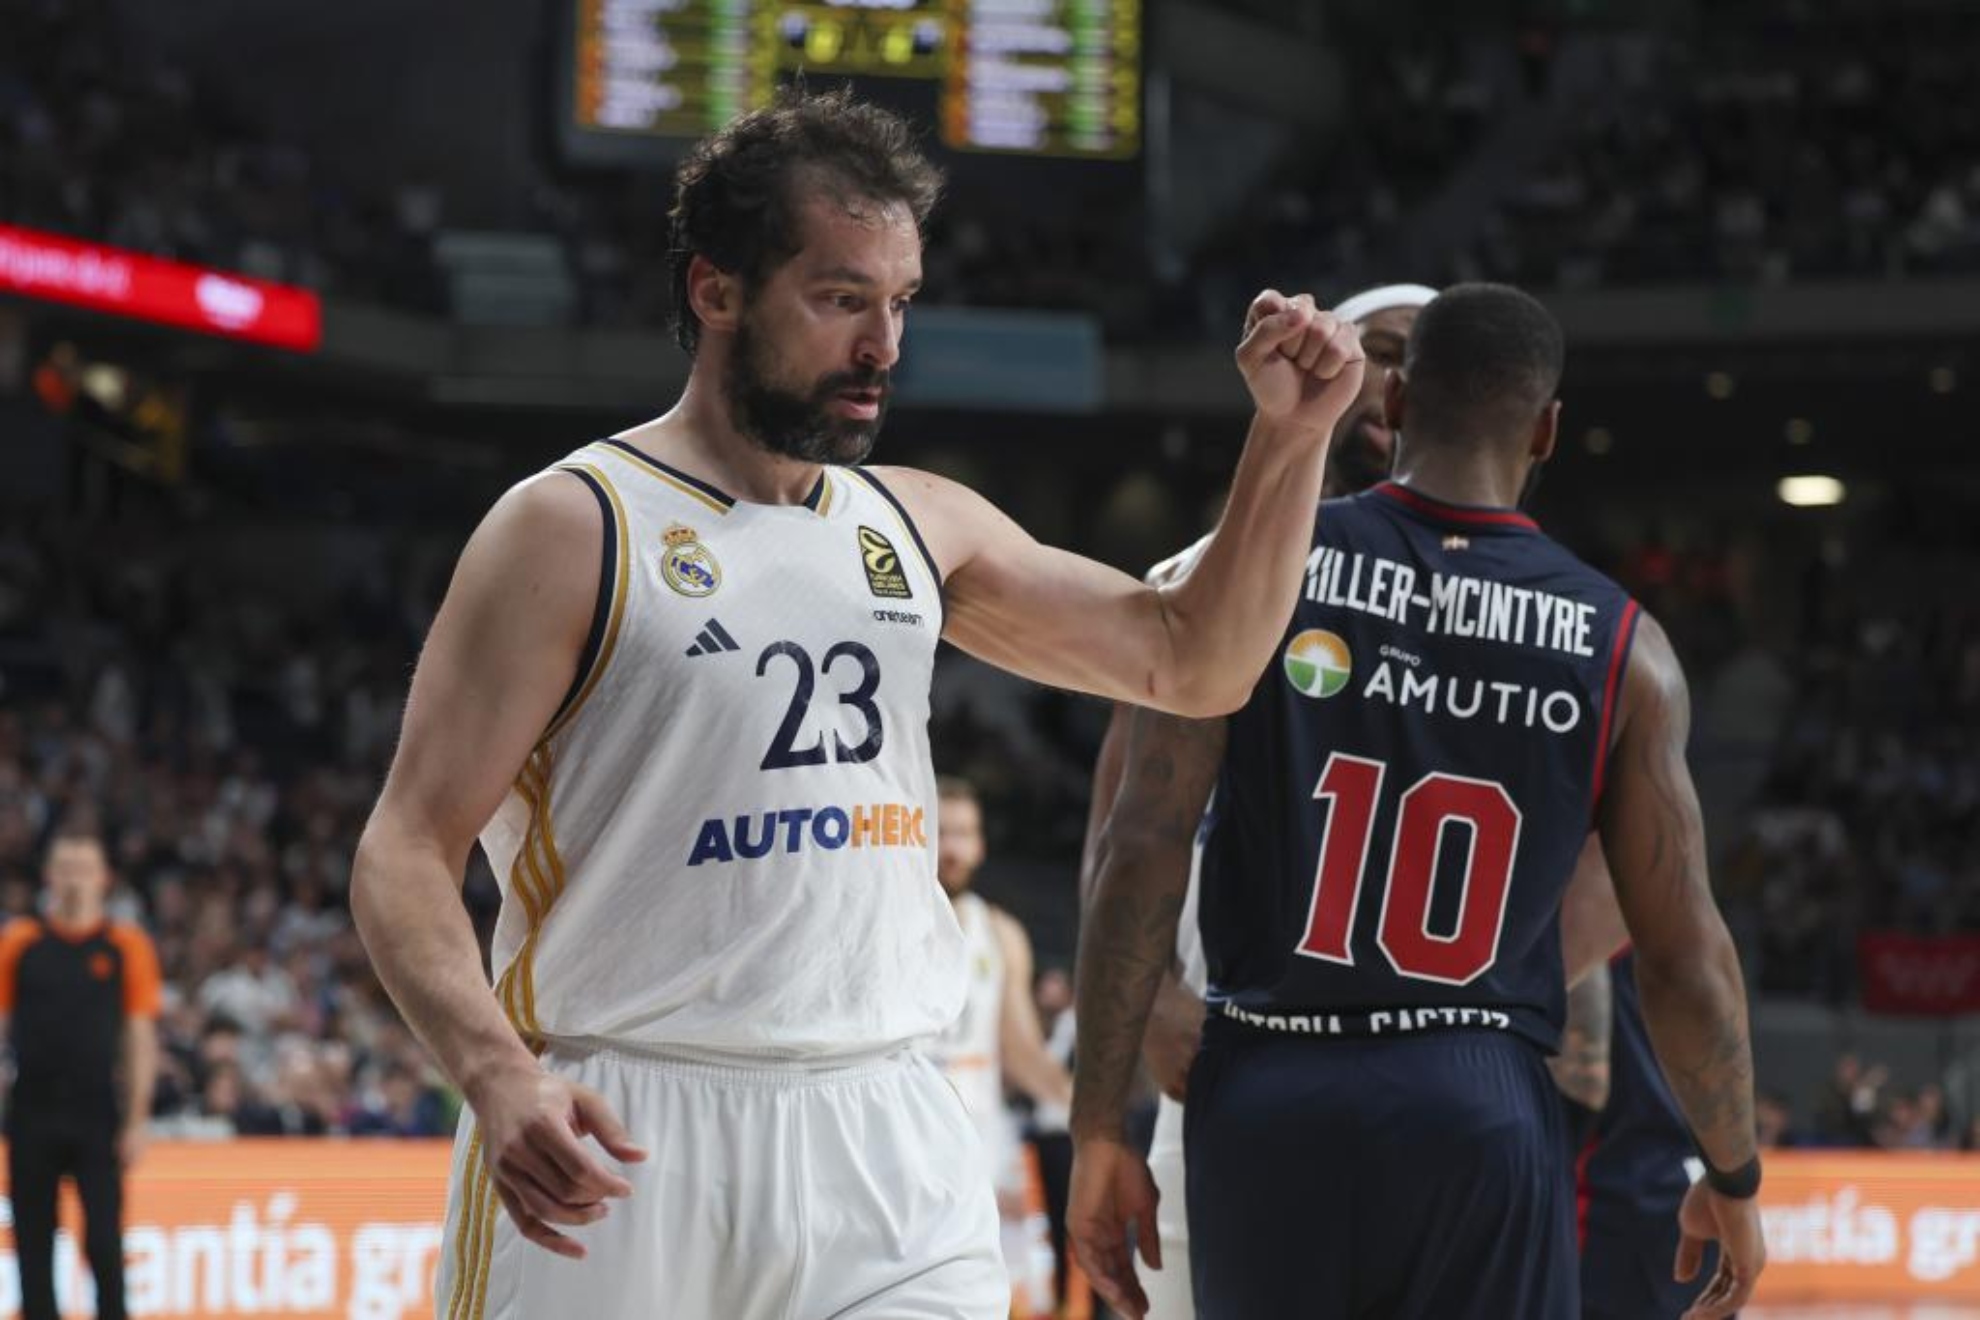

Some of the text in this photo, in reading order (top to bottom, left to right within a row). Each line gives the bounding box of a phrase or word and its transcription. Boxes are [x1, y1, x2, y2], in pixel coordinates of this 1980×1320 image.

[755, 640, 883, 771] 23
[1363, 661, 1580, 733] AMUTIO
[1379, 644, 1421, 667] GRUPO
[1295, 751, 1522, 986] 10
